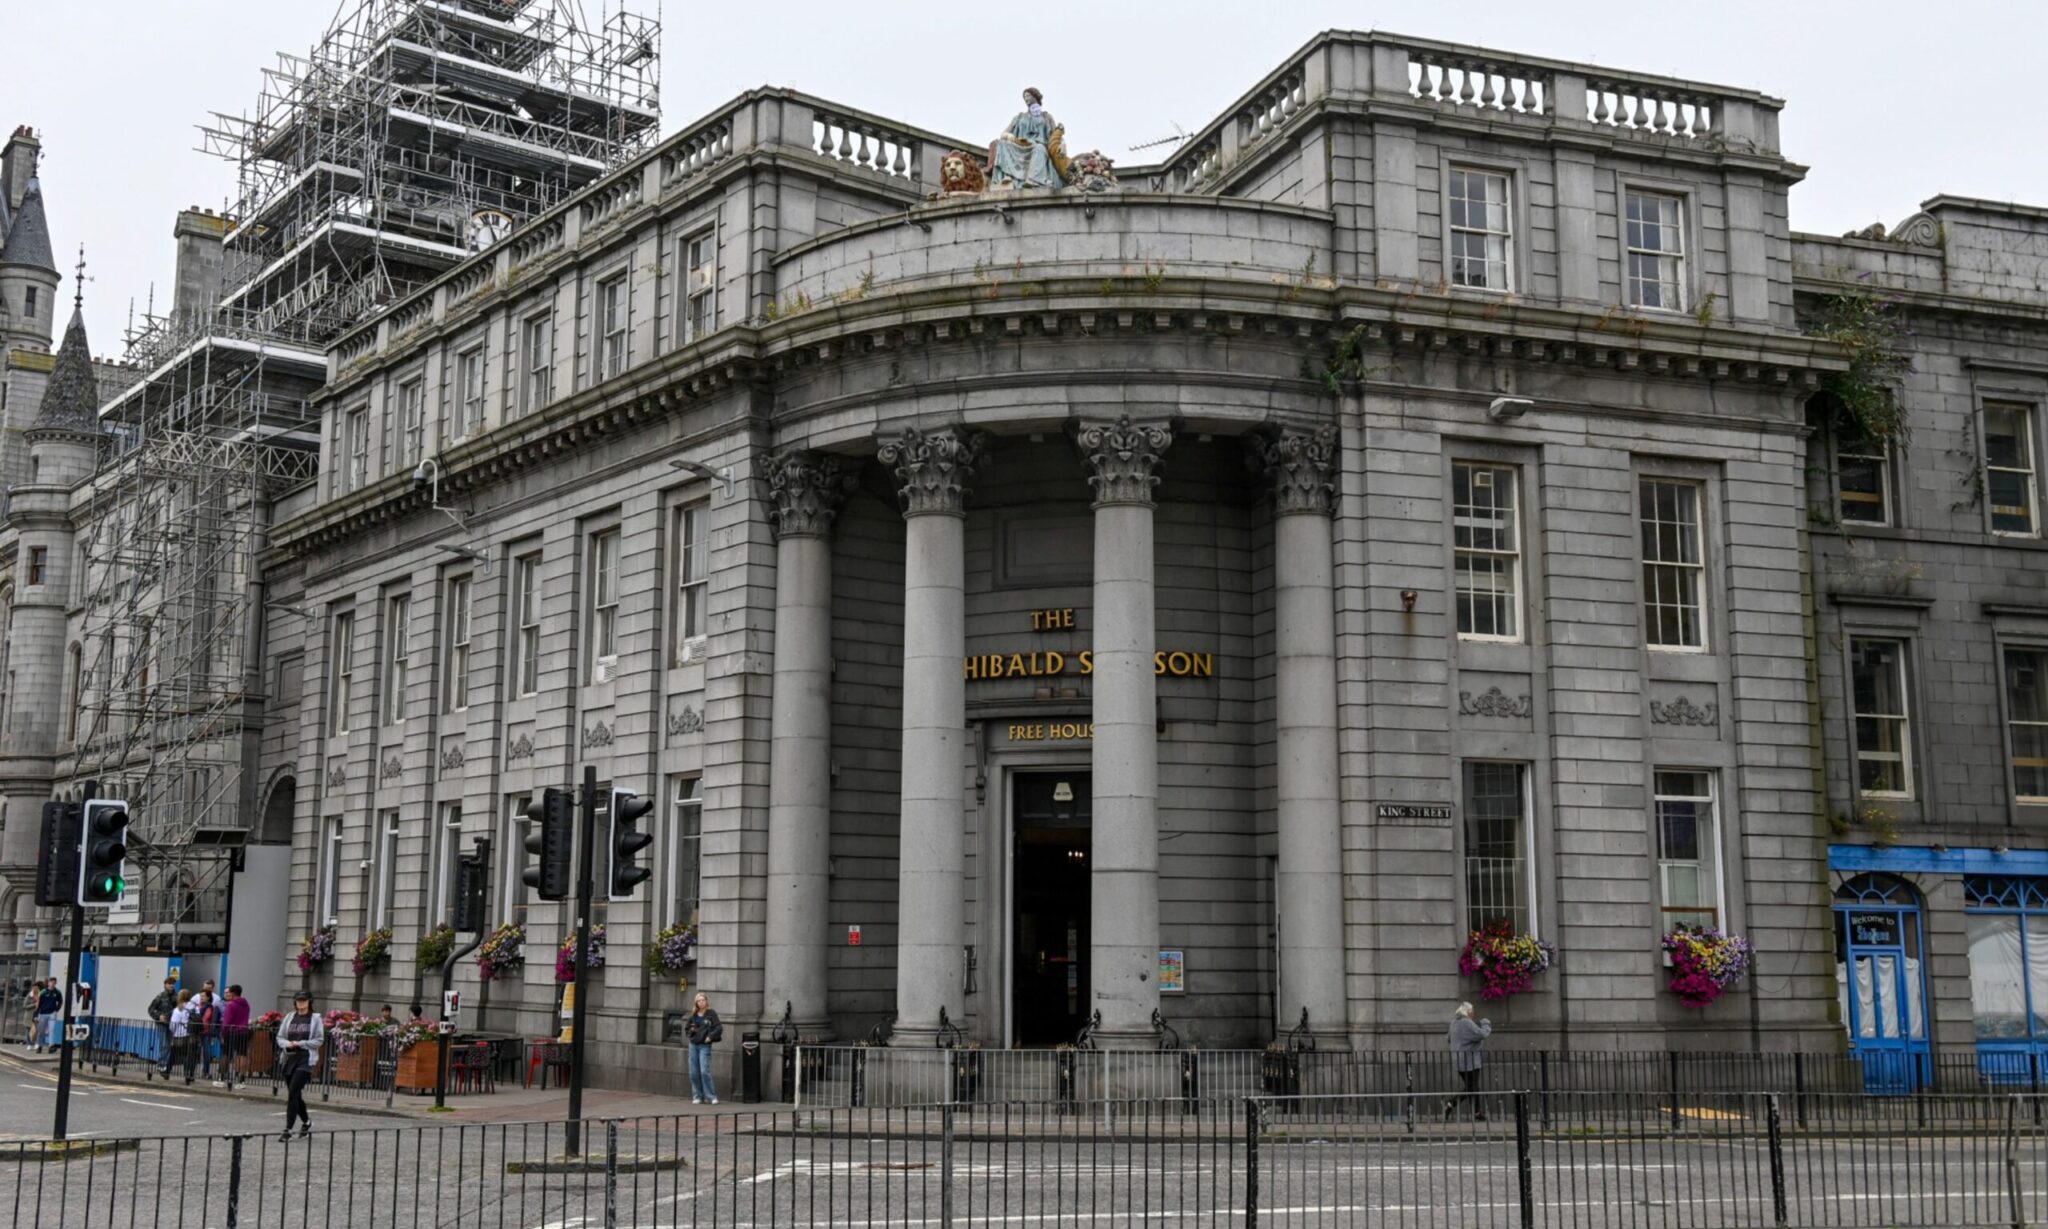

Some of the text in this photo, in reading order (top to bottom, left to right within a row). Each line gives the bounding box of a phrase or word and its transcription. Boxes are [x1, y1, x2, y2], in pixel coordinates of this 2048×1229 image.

[1030, 608, 1074, 630] THE
[964, 651, 1064, 679] HIBALD
[1008, 723, 1094, 740] FREE HOUS
[1379, 806, 1450, 818] KING STREET
[1851, 914, 1884, 925] Welcome
